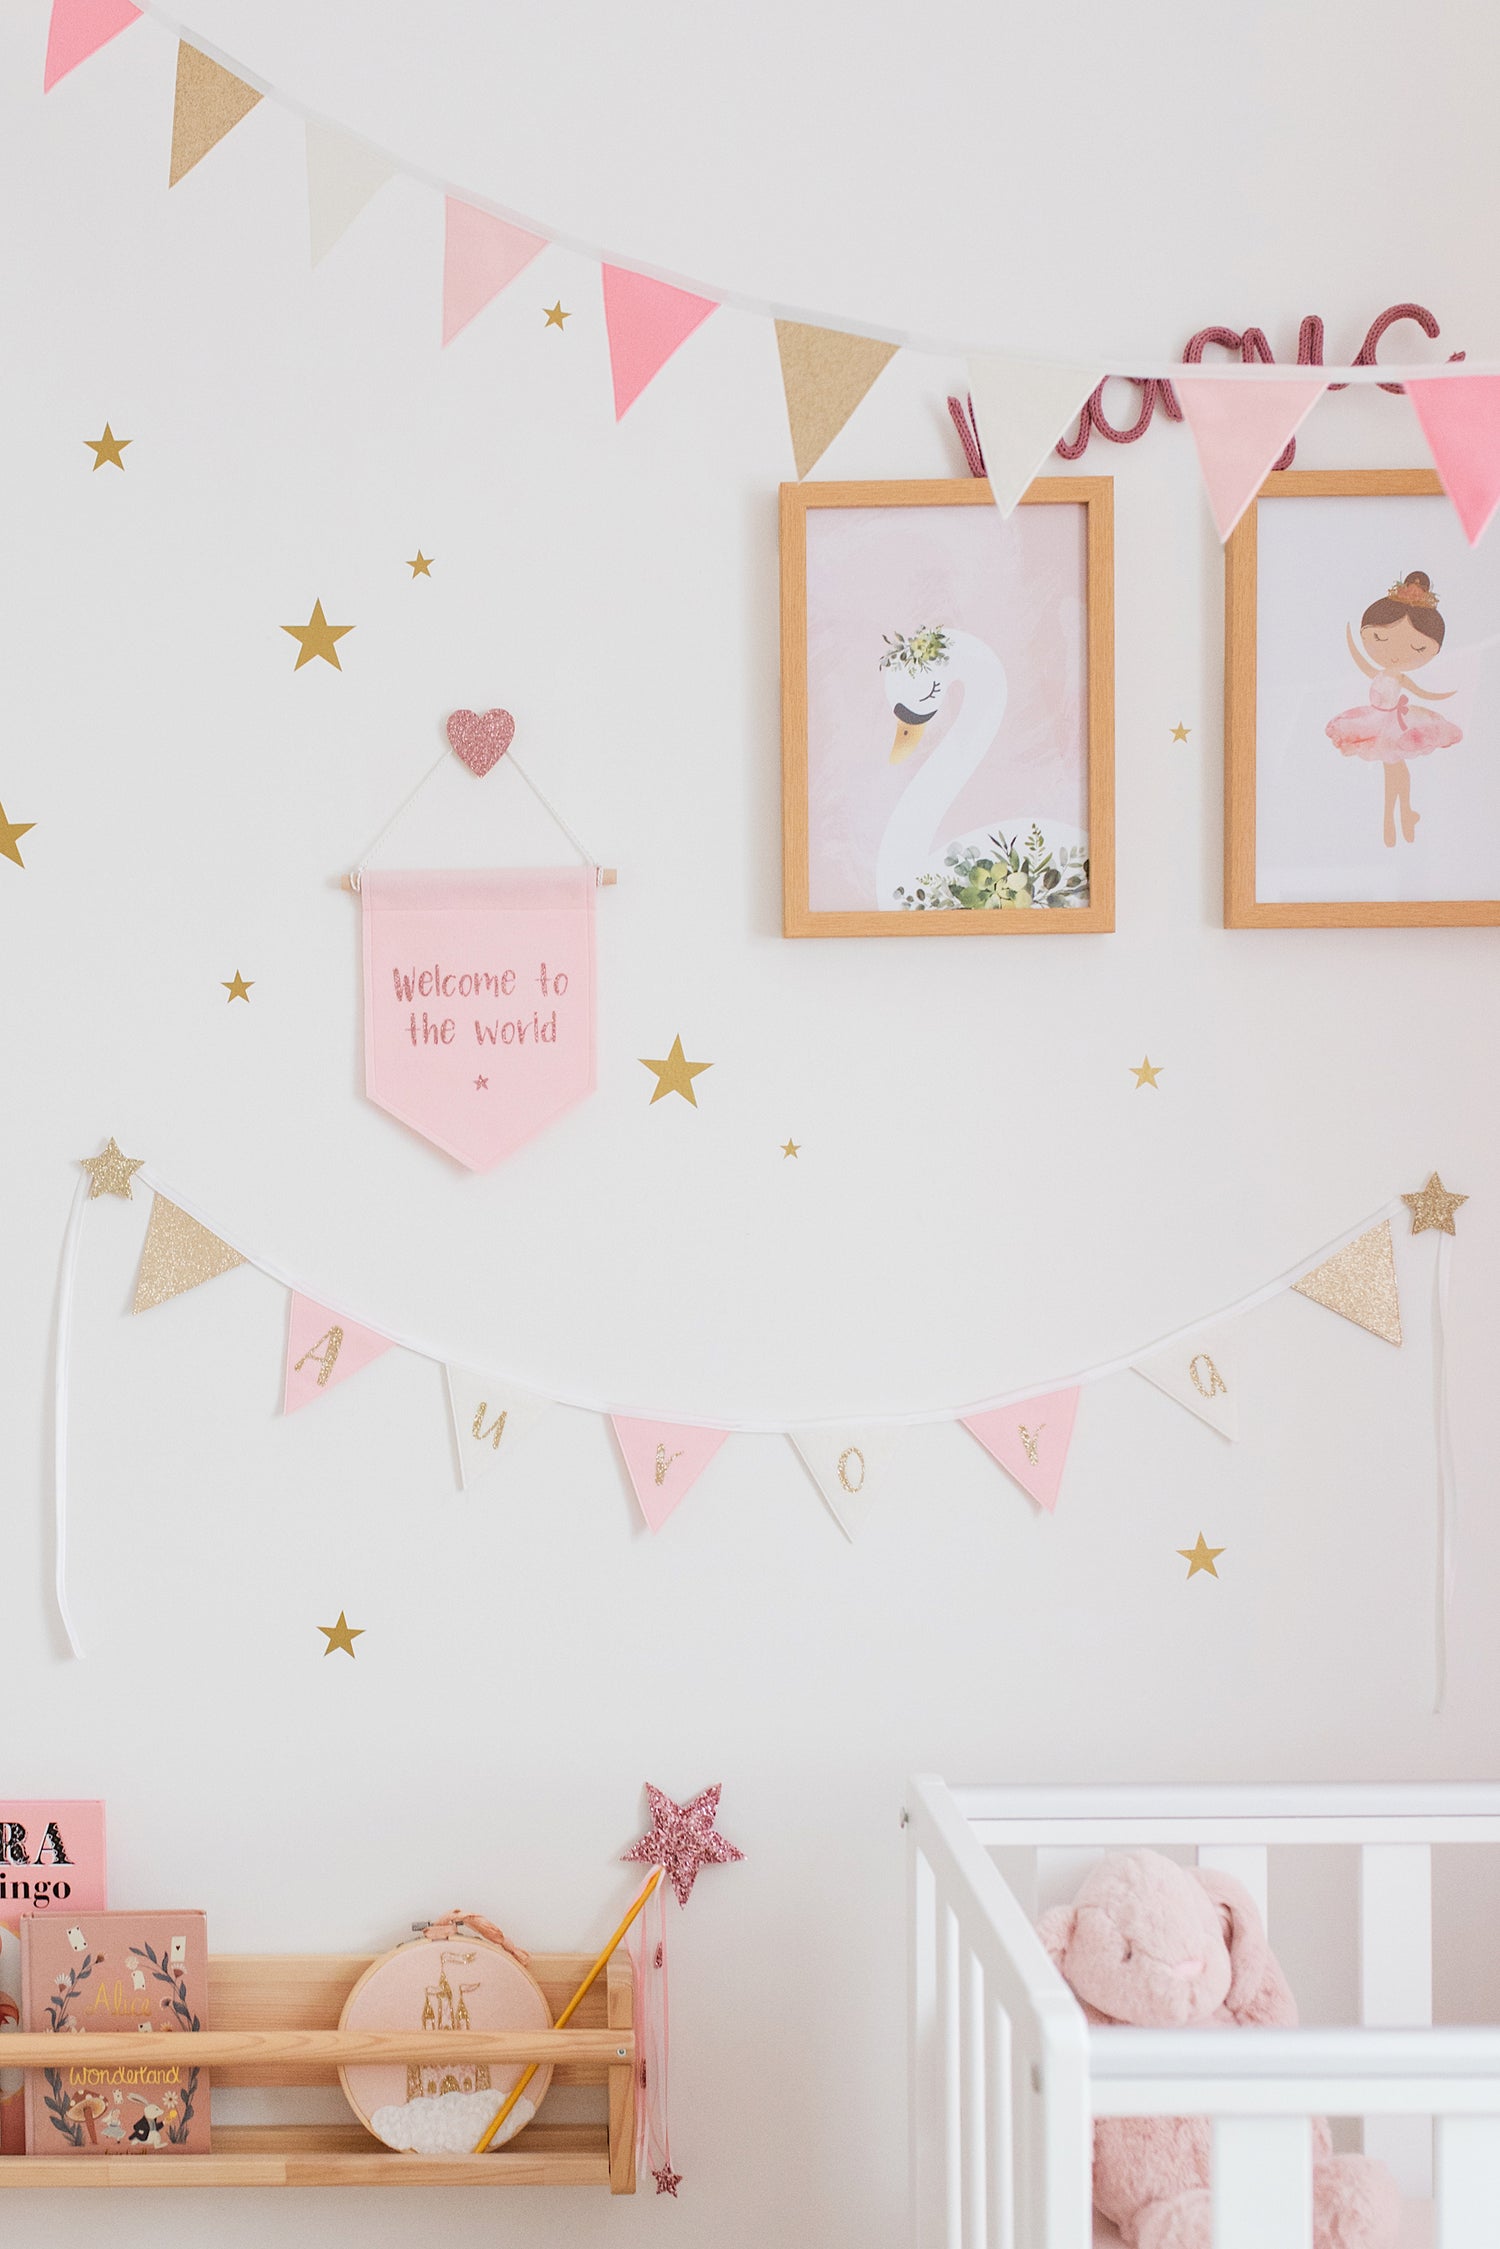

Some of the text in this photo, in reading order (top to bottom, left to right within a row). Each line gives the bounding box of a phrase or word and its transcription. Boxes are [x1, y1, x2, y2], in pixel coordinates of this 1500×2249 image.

[393, 962, 569, 1003] Welcome to
[405, 1010, 558, 1047] the world
[84, 1981, 152, 2016] Alice
